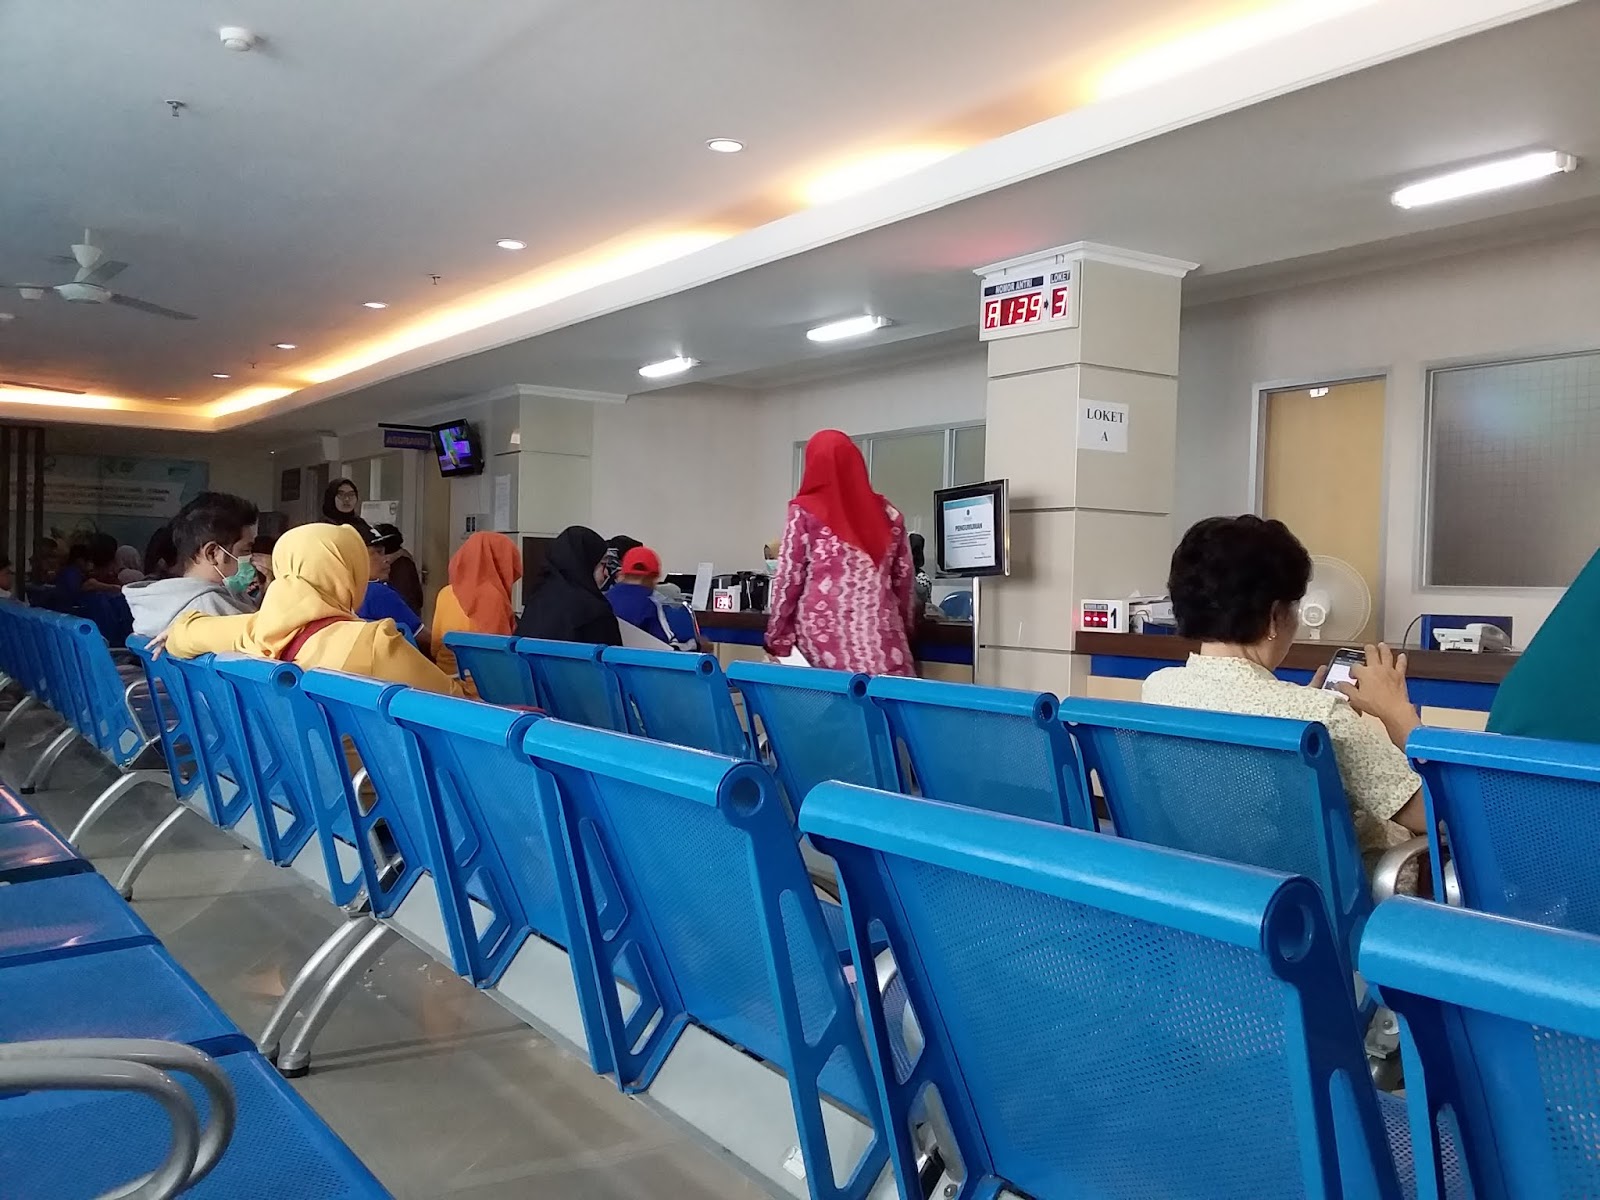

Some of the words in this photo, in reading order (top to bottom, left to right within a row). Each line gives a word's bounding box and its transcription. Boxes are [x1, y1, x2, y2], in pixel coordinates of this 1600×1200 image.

[1051, 271, 1070, 283] LOKET
[995, 283, 1015, 294] NOMOR
[1016, 279, 1032, 290] ANTRI
[987, 303, 999, 327] A
[1009, 295, 1042, 324] 139
[1054, 290, 1068, 317] 3
[1087, 408, 1125, 424] LOKET
[1101, 431, 1109, 442] A
[1110, 607, 1117, 629] 1
